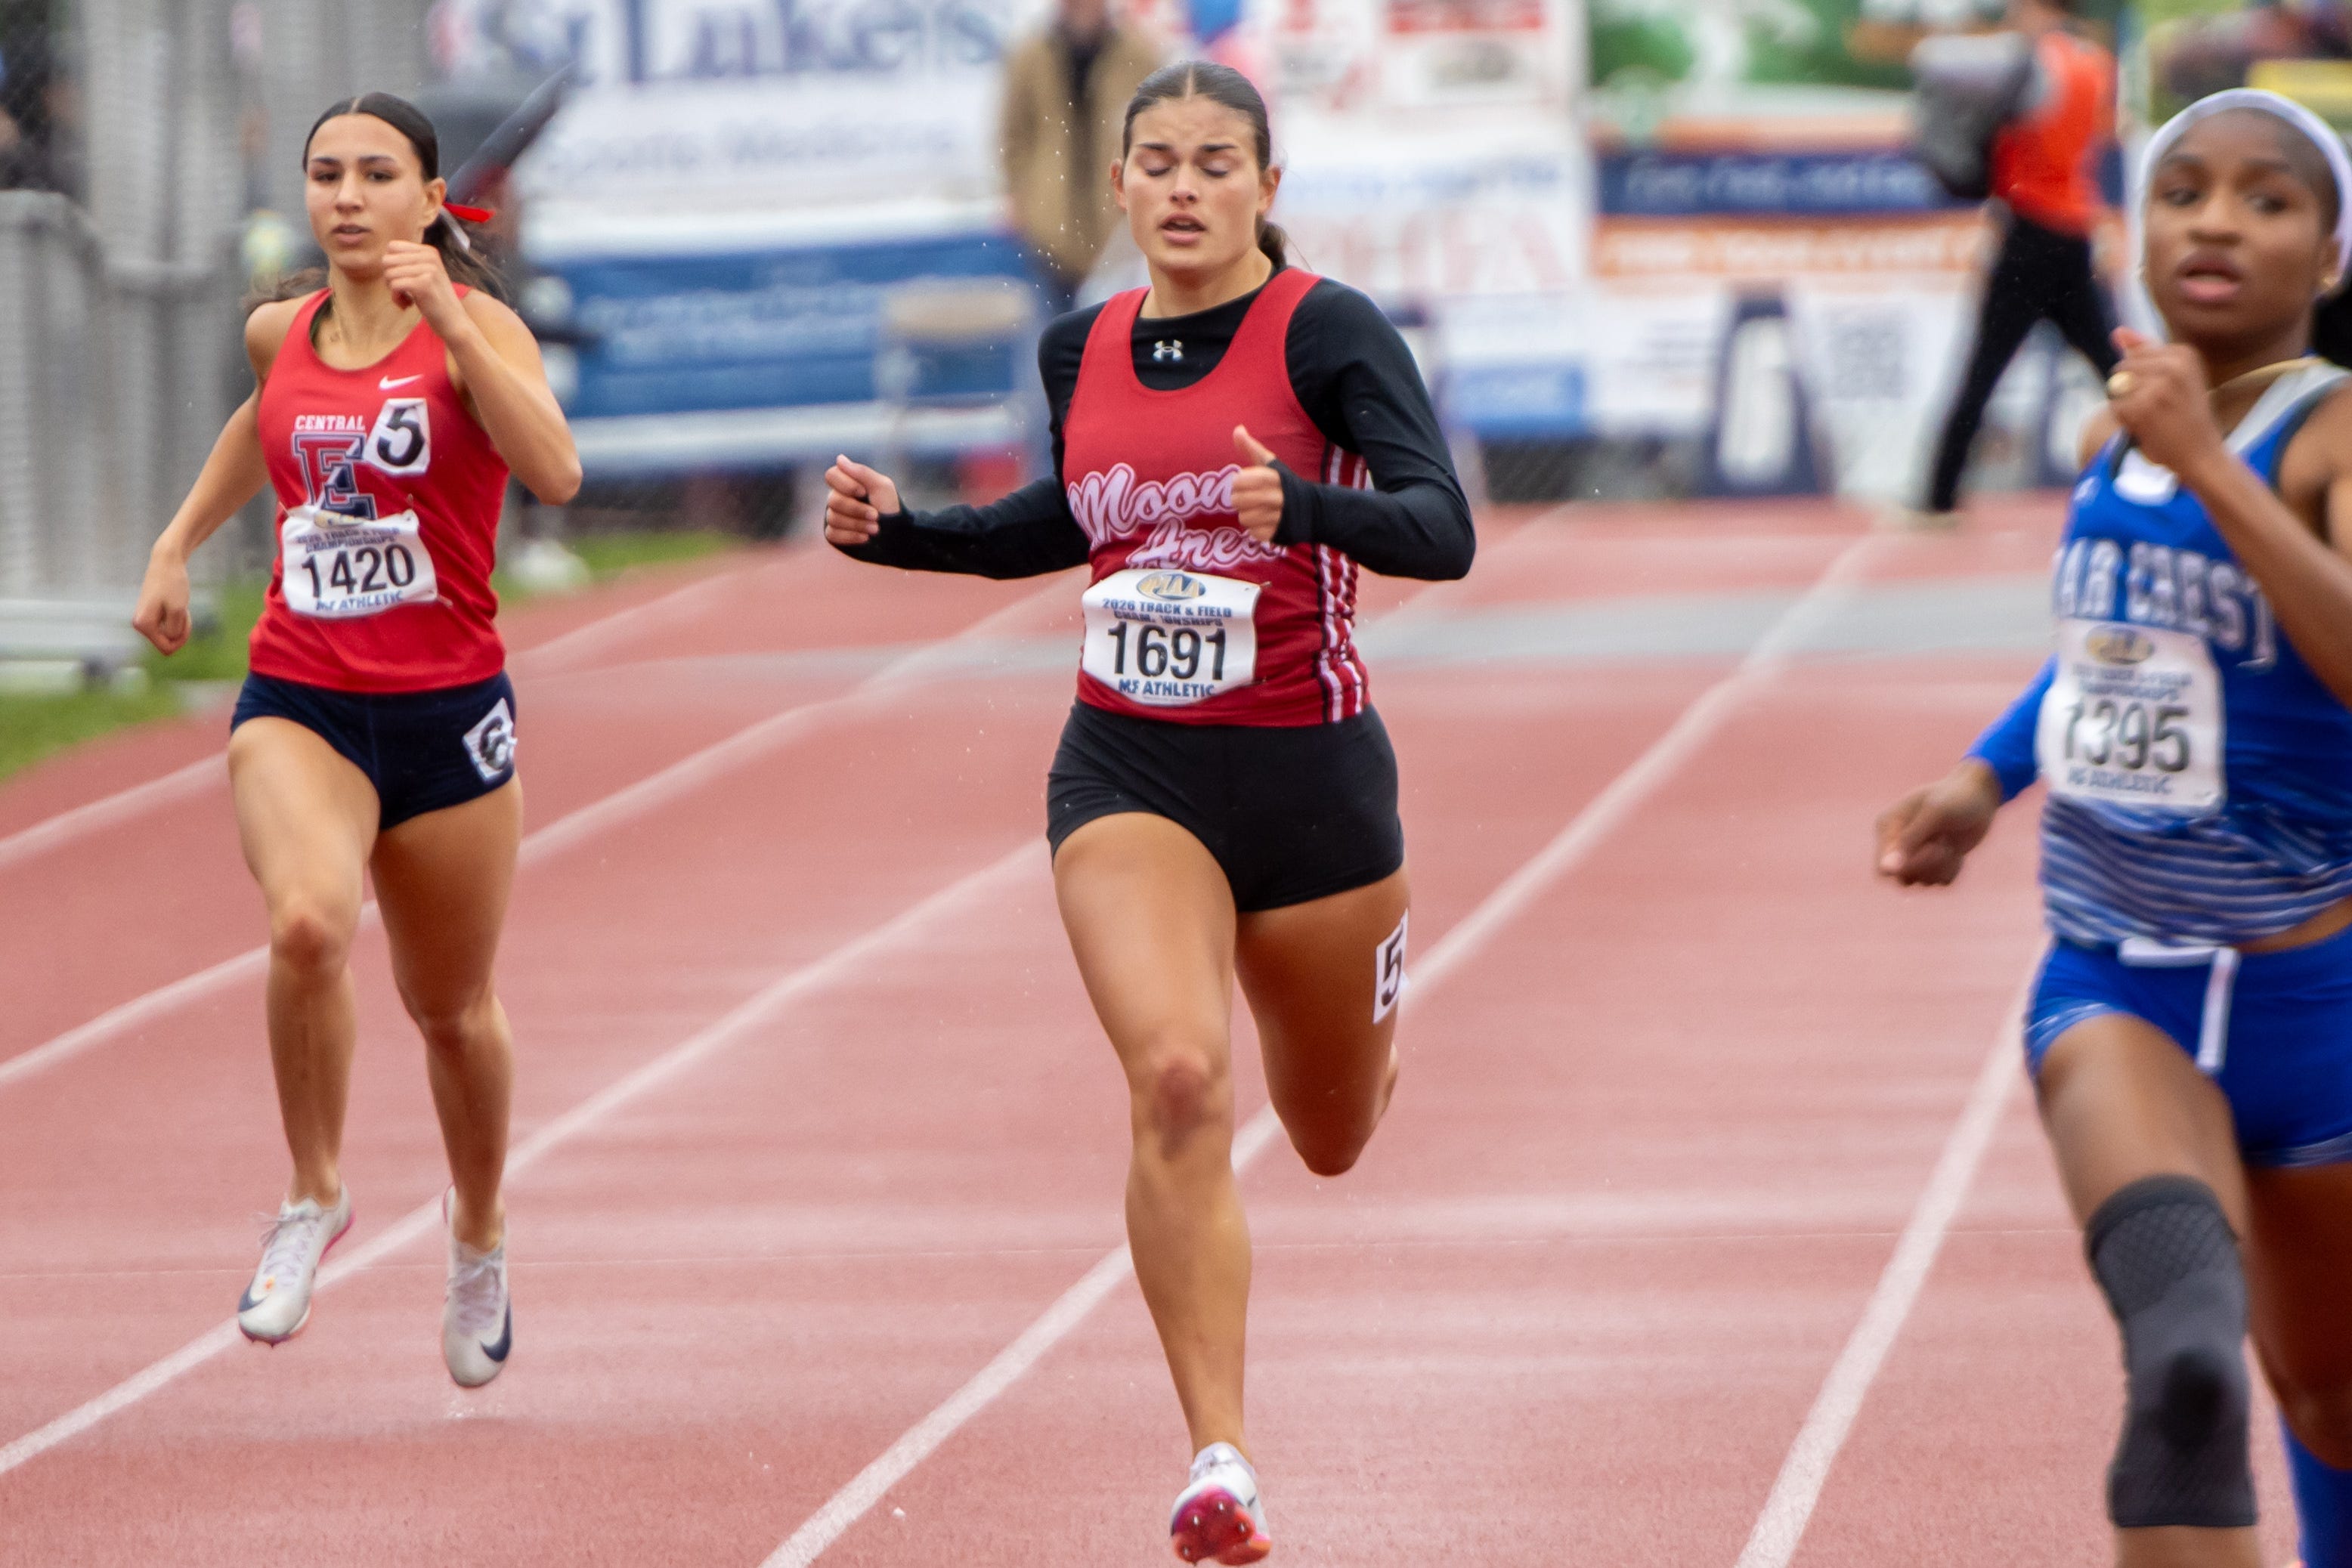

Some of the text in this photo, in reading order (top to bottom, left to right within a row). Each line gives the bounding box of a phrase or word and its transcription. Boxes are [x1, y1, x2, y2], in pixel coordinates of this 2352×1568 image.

[294, 415, 365, 431] CENTRAL
[377, 407, 426, 468] 5
[302, 543, 416, 598] 1420
[1103, 598, 1135, 610] 2026
[1140, 602, 1181, 614] TRACK
[1198, 606, 1233, 617] FIELD
[1108, 621, 1226, 680] 1691
[1143, 682, 1215, 697] ATHLETIC
[2063, 699, 2190, 773] 1395
[1381, 922, 1403, 1007] 5
